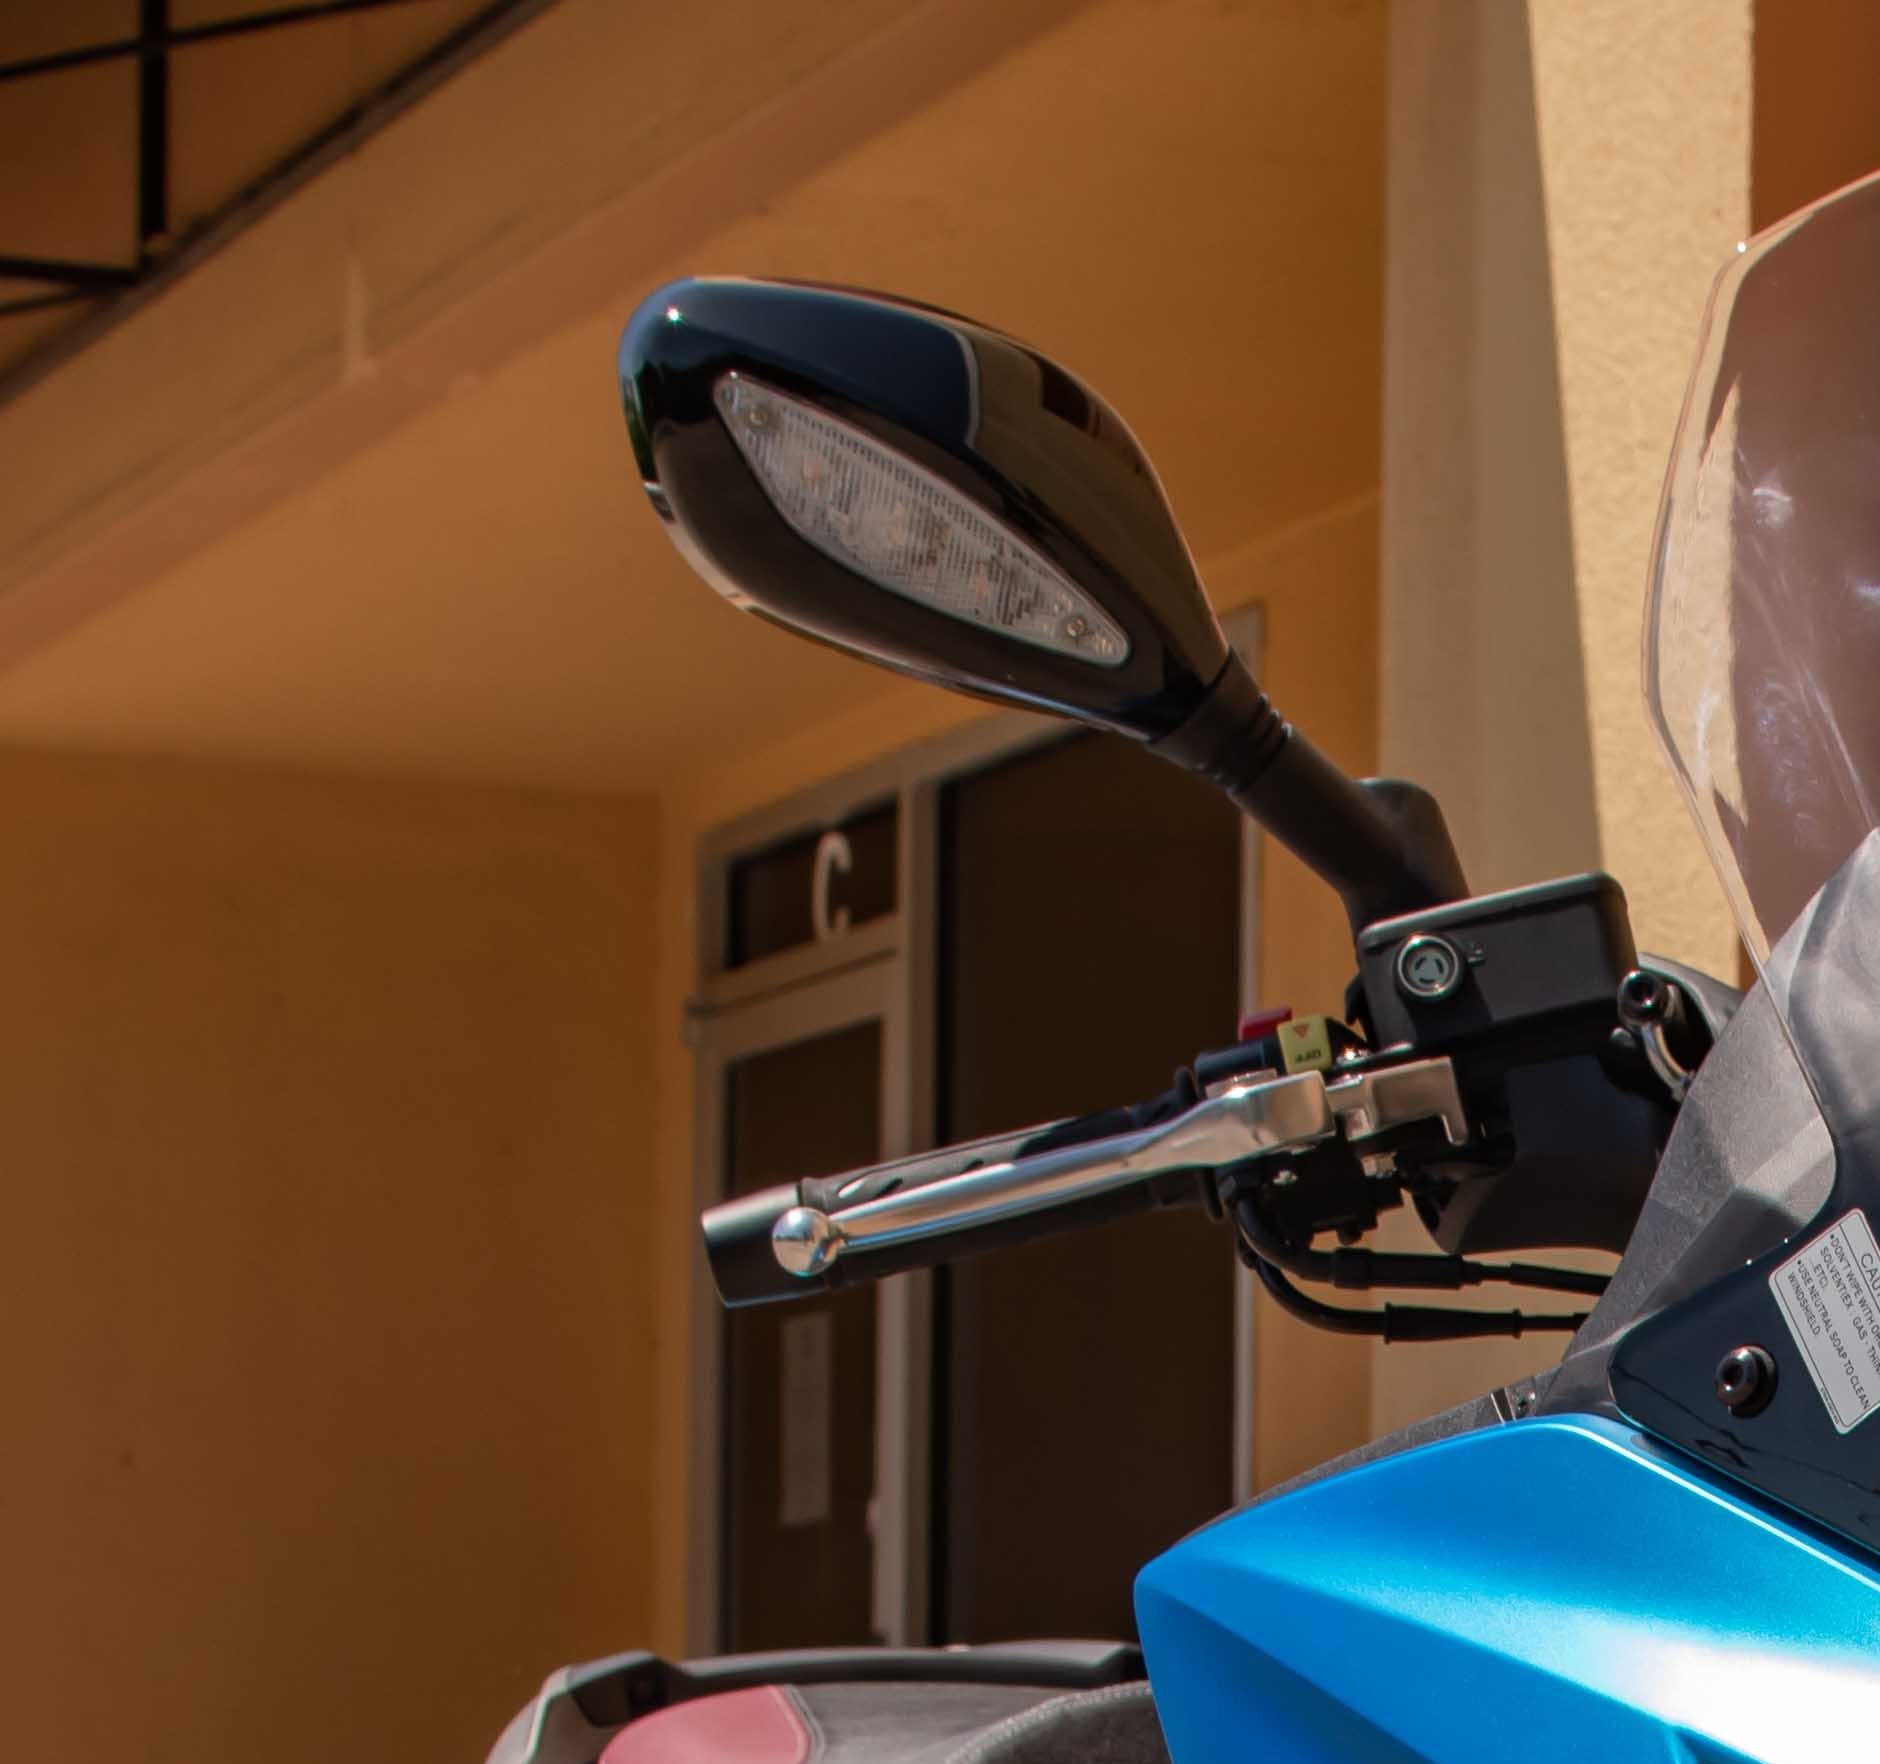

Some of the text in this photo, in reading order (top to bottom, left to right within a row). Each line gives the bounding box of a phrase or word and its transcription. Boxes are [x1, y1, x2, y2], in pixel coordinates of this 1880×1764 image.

[811, 830, 853, 940] C
[1830, 1238, 1851, 1271] DON'T
[1845, 1270, 1863, 1298] WIPE
[1857, 1296, 1875, 1325] WITH
[1851, 1315, 1868, 1341] GAS
[1797, 1264, 1870, 1409] USE NEUTRAL SOAP TO CLEAN
